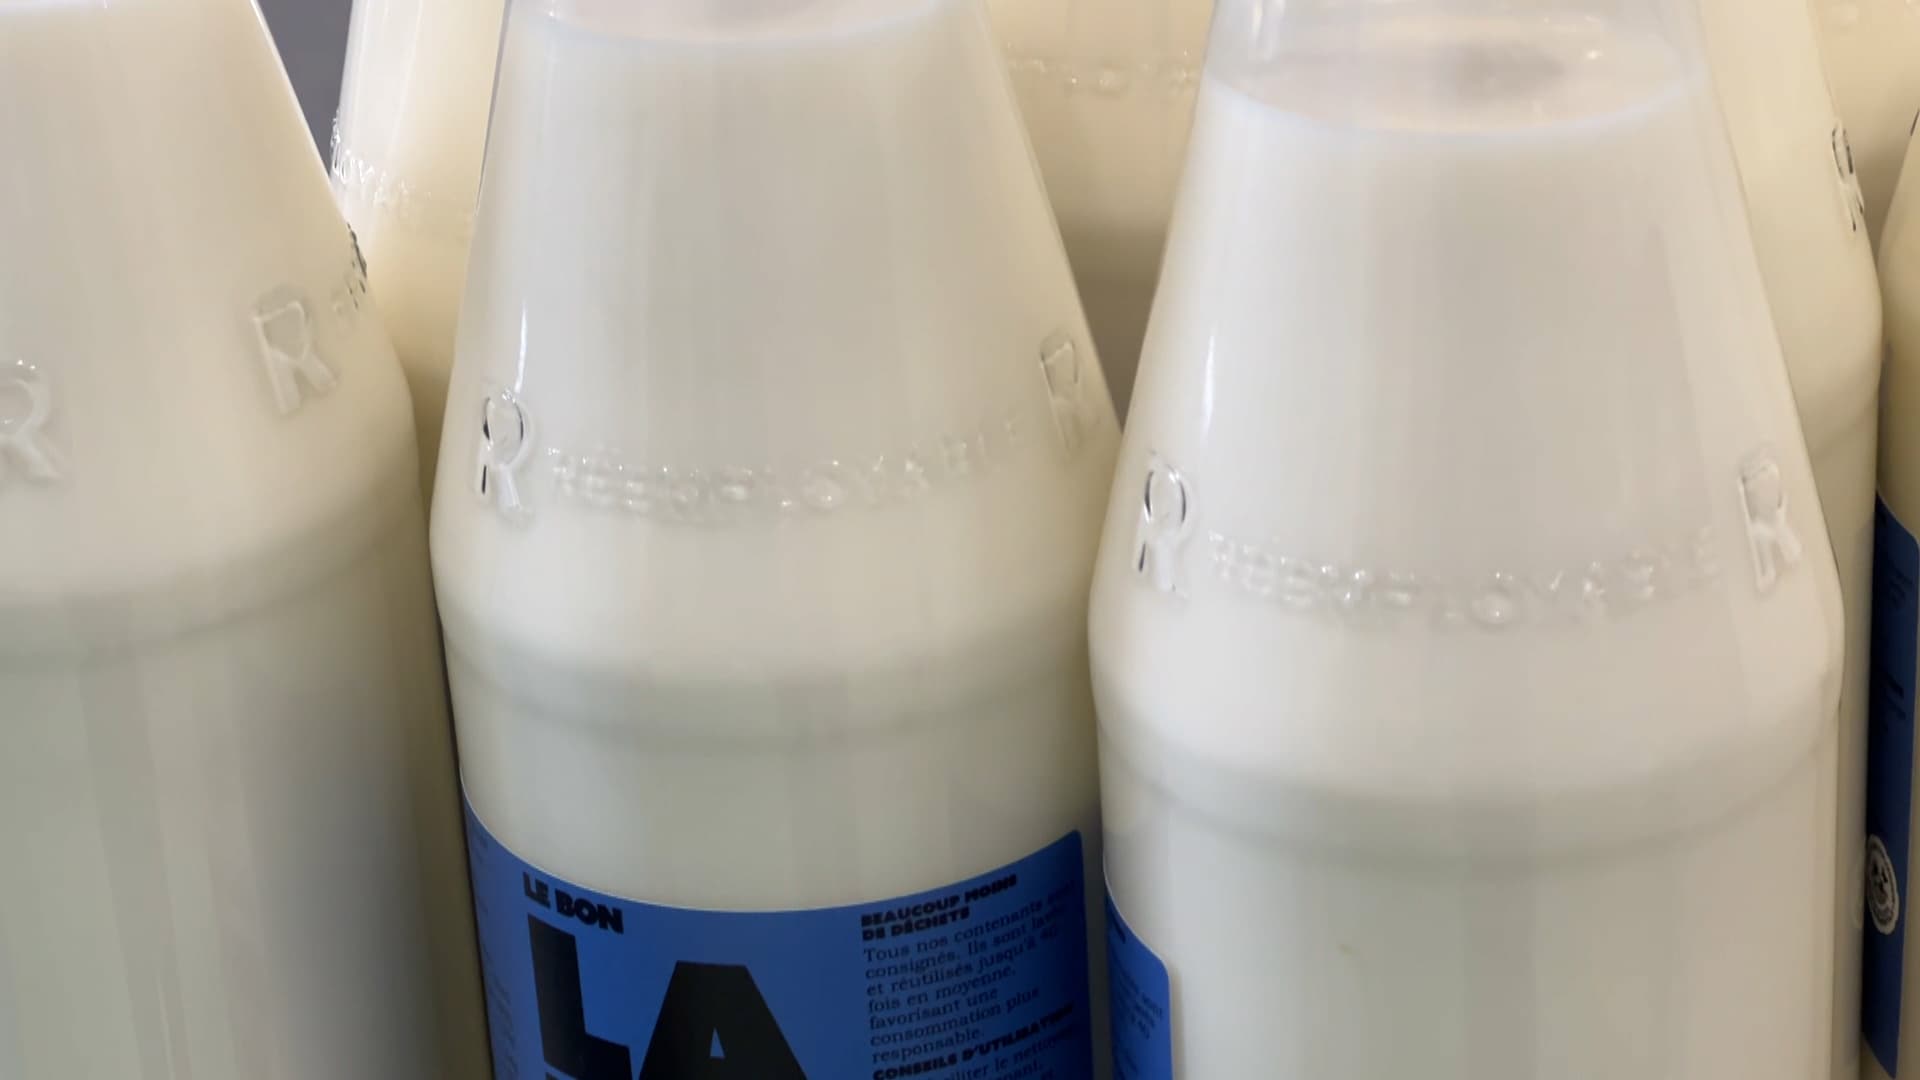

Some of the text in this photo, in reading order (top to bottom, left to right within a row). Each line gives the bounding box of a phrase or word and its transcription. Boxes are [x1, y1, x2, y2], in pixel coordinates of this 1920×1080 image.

[252, 288, 340, 416] R
[478, 388, 532, 516] R
[1134, 460, 1190, 601] R
[1738, 454, 1802, 594] R
[522, 871, 624, 934] LE BON
[861, 894, 959, 927] BEAUCOUP
[965, 874, 1017, 903] MOINS
[862, 906, 970, 941] DE DÉCHETS
[863, 900, 1043, 962] Tous nos contenants
[866, 951, 960, 979] consignés.
[968, 941, 987, 955] Ils
[993, 926, 1027, 946] sont
[527, 913, 808, 1080] LA
[867, 984, 883, 996] et
[891, 962, 973, 992] réutilisés
[869, 996, 900, 1013] fois
[907, 990, 928, 1004] en
[870, 988, 998, 1030] favorisant une
[870, 987, 1039, 1046] consommation plus
[872, 1030, 985, 1064] responsable.
[873, 1053, 958, 1080] CONSEILS
[995, 1057, 1009, 1072] le
